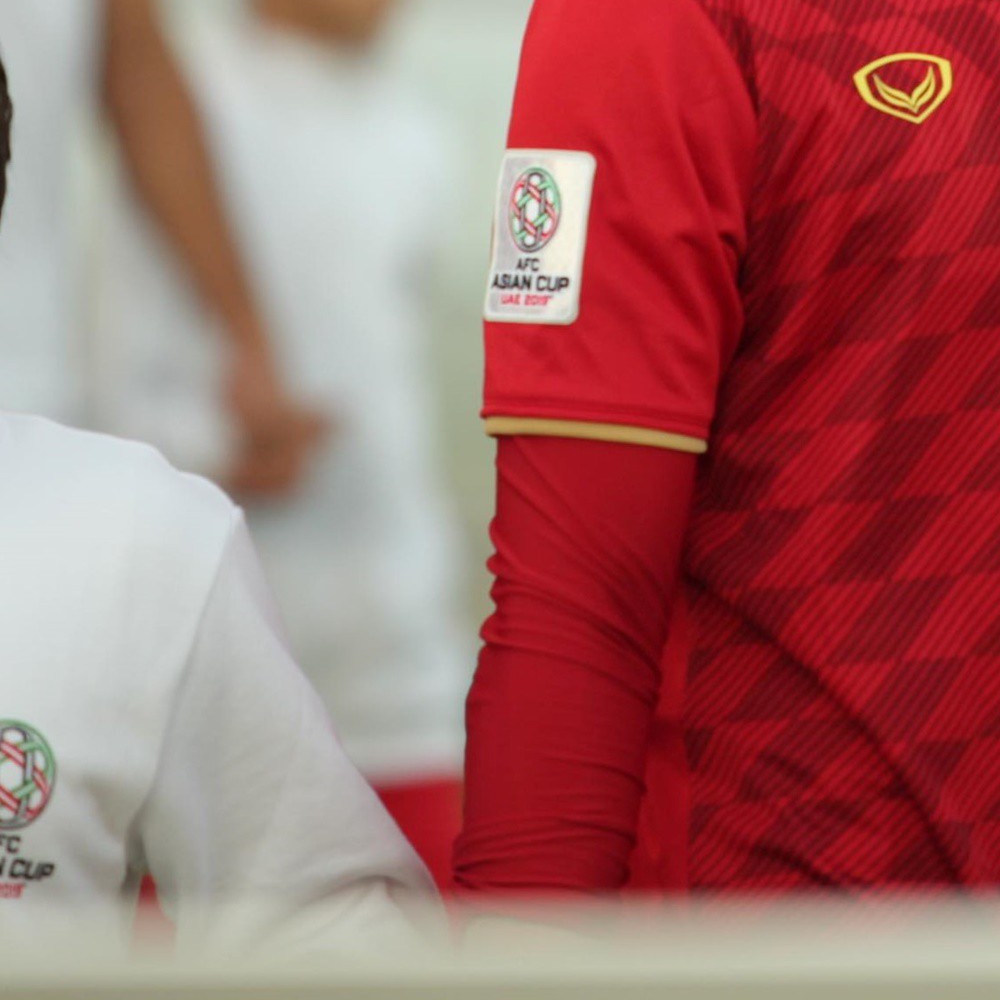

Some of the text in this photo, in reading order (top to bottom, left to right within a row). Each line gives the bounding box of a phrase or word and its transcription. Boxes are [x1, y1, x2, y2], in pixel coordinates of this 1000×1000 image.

[516, 257, 541, 272] AFC
[491, 273, 570, 292] ASIAN CUP
[0, 834, 21, 854] FC
[9, 858, 55, 881] CUP
